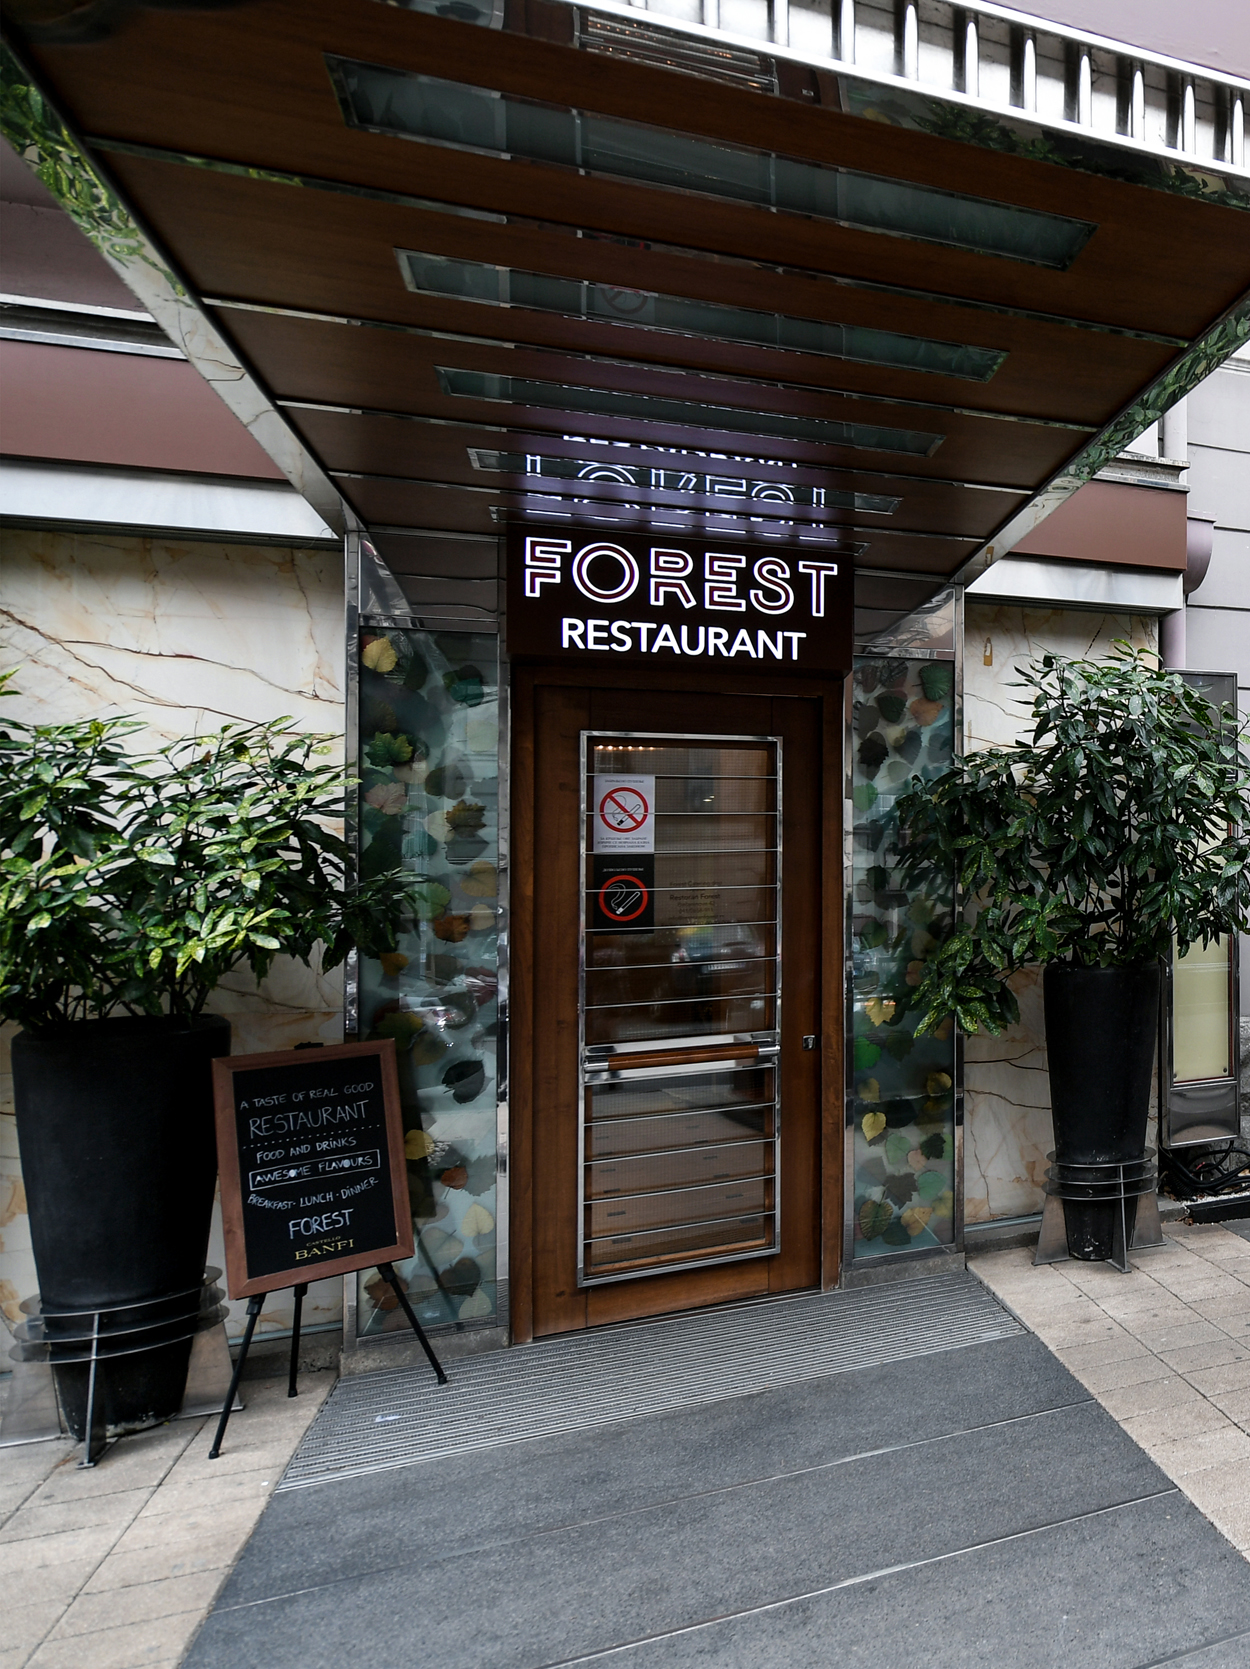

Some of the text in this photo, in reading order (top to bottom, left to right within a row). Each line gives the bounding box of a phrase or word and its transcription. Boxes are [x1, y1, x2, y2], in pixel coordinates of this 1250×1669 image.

[524, 535, 839, 618] FOREST
[561, 617, 807, 661] RESTAURANT
[240, 1082, 374, 1110] A TASTE OF REAL GOOD
[249, 1100, 369, 1139] RESTAURANT
[256, 1149, 285, 1164] FOOD
[289, 1144, 311, 1157] AND
[254, 1155, 373, 1185] AWESOME FLAVOURS
[300, 1191, 334, 1208] LUNCH
[288, 1208, 354, 1240] FOREST
[295, 1239, 354, 1260] BANFI
[306, 1236, 342, 1247] CASTELLO
